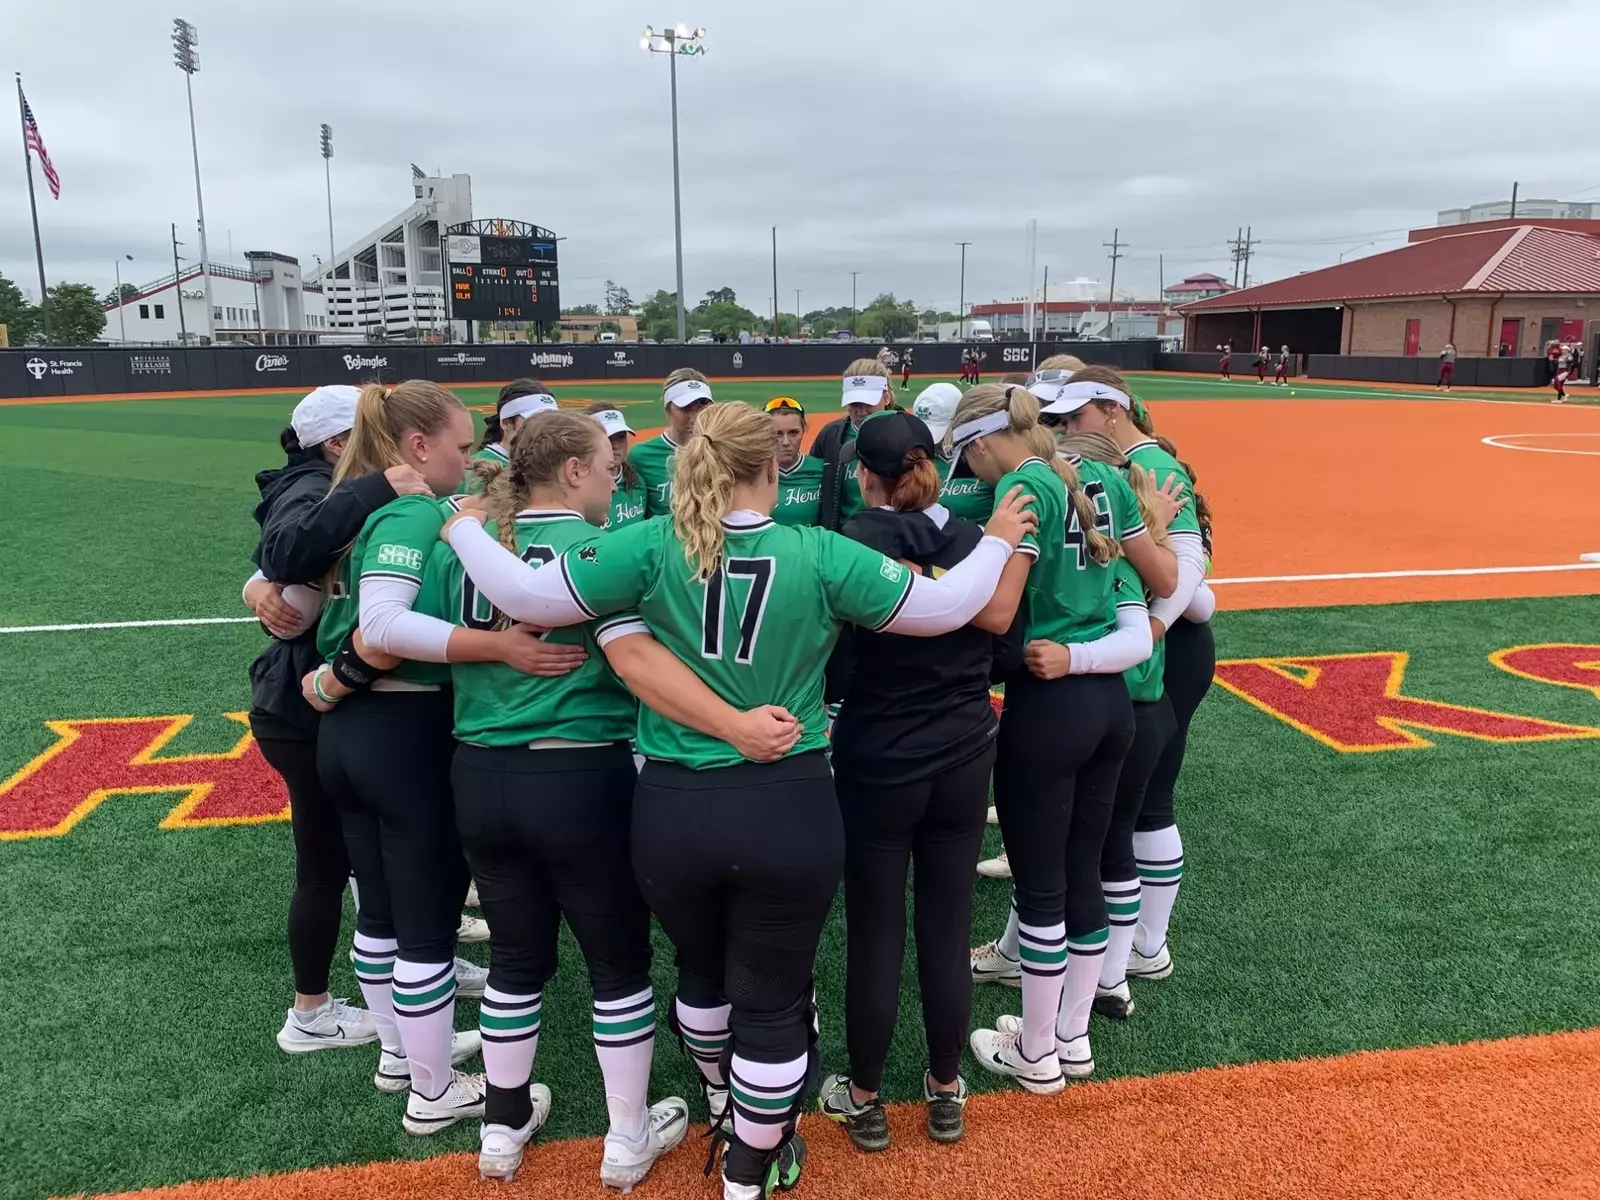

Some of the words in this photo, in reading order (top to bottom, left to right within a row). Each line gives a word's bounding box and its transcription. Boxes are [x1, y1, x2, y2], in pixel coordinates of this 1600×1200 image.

[466, 266, 472, 276] 0
[501, 267, 506, 277] 0
[527, 268, 532, 278] 0
[256, 354, 289, 371] Cane's
[343, 354, 387, 370] Bojangles
[530, 352, 573, 367] Johnny's
[1003, 348, 1029, 362] SBC
[786, 484, 822, 506] Herd
[939, 479, 981, 497] Herd
[615, 496, 644, 524] Herd
[378, 544, 422, 570] SBC
[699, 556, 776, 666] 17
